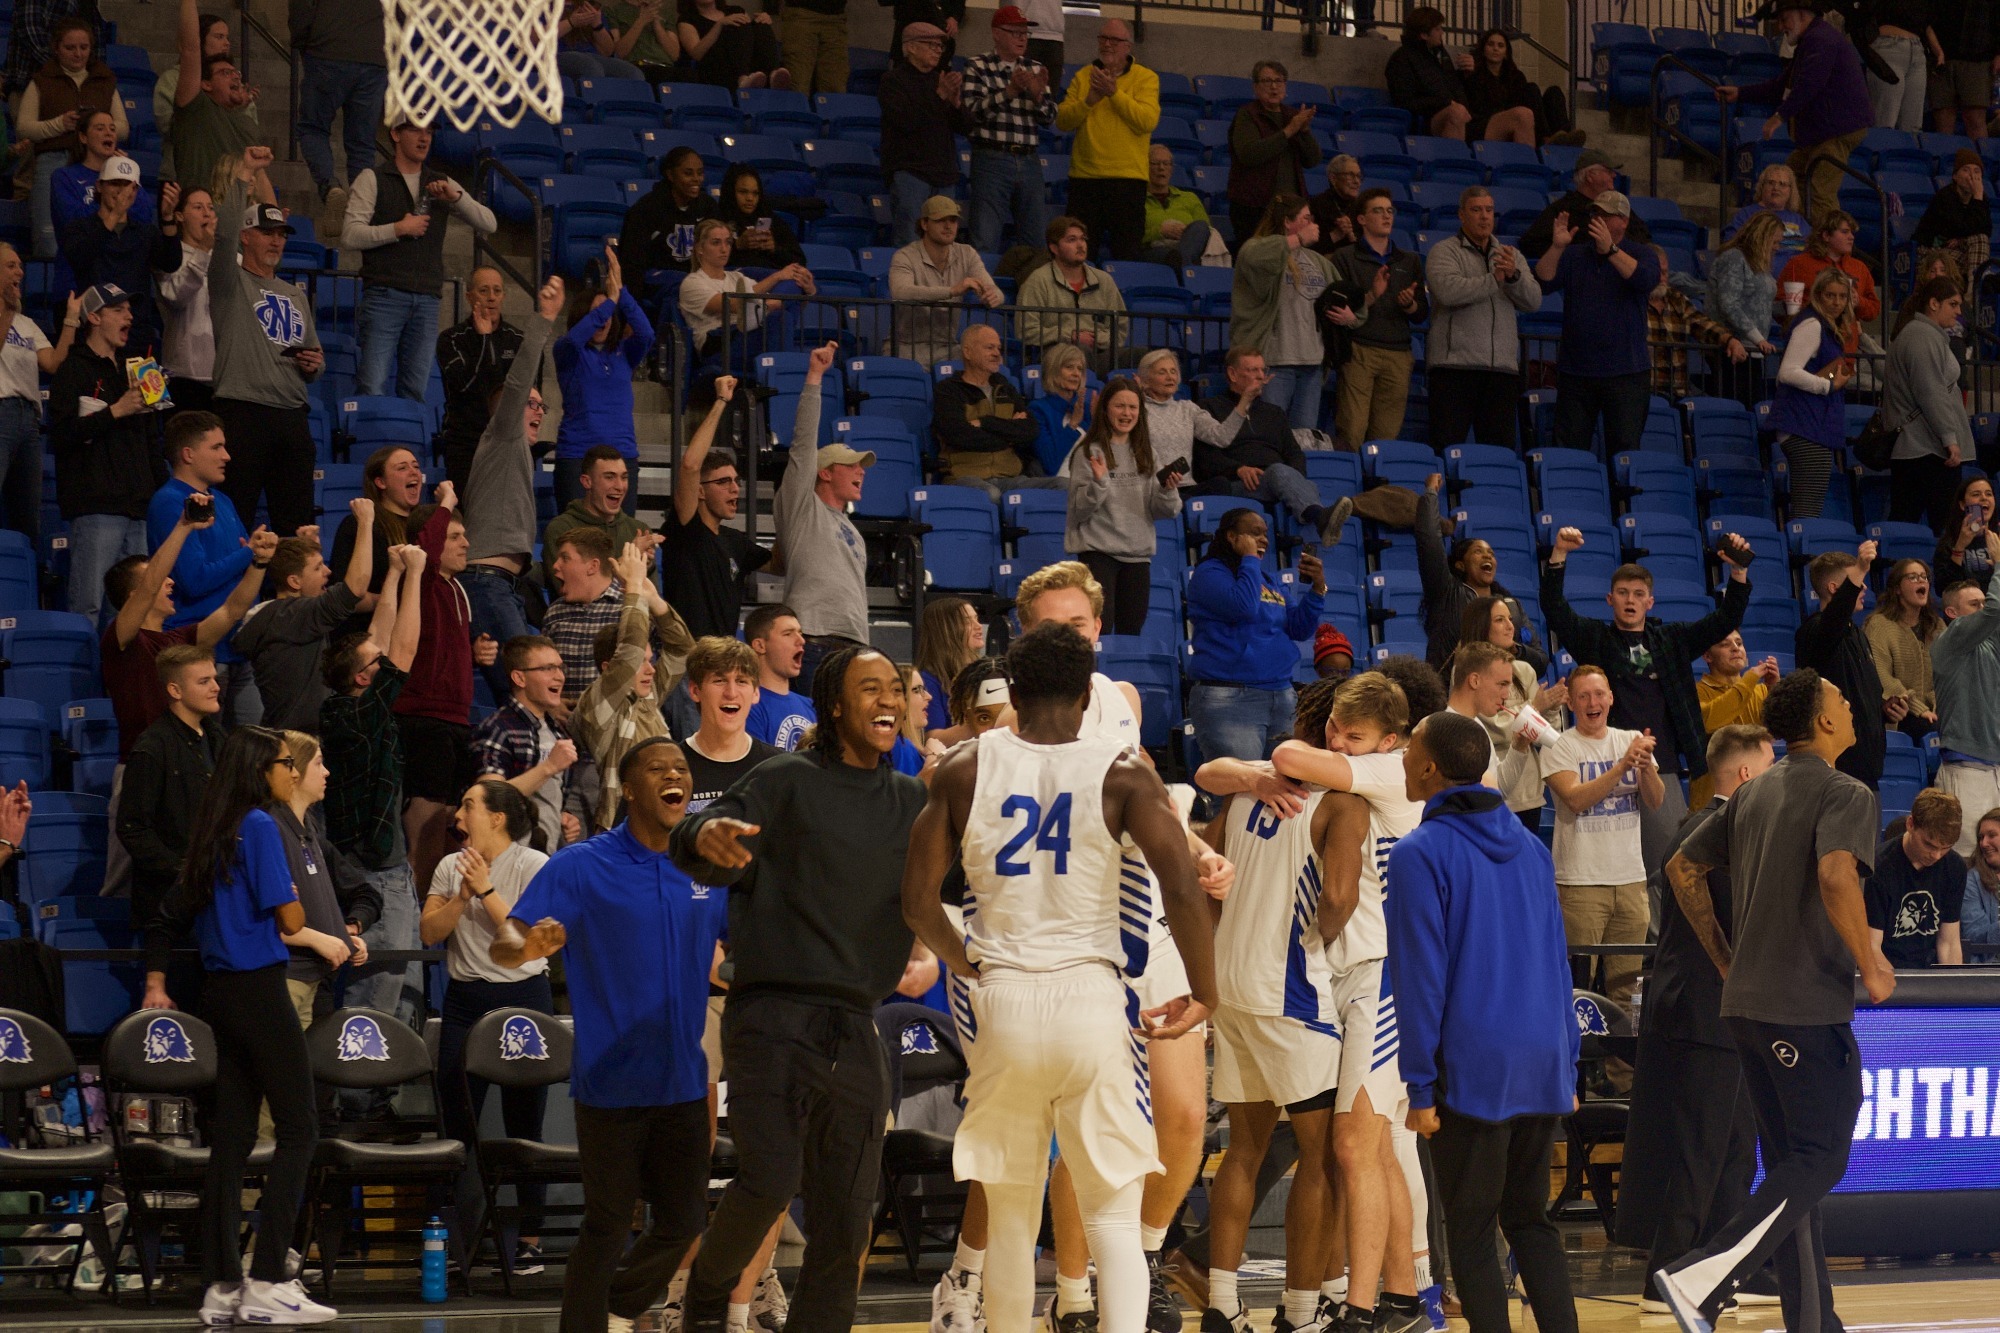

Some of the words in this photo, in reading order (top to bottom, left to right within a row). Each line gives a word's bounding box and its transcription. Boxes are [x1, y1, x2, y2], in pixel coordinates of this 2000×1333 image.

[692, 790, 723, 800] NORTH
[995, 792, 1072, 877] 24
[1852, 1066, 2000, 1140] HTH
